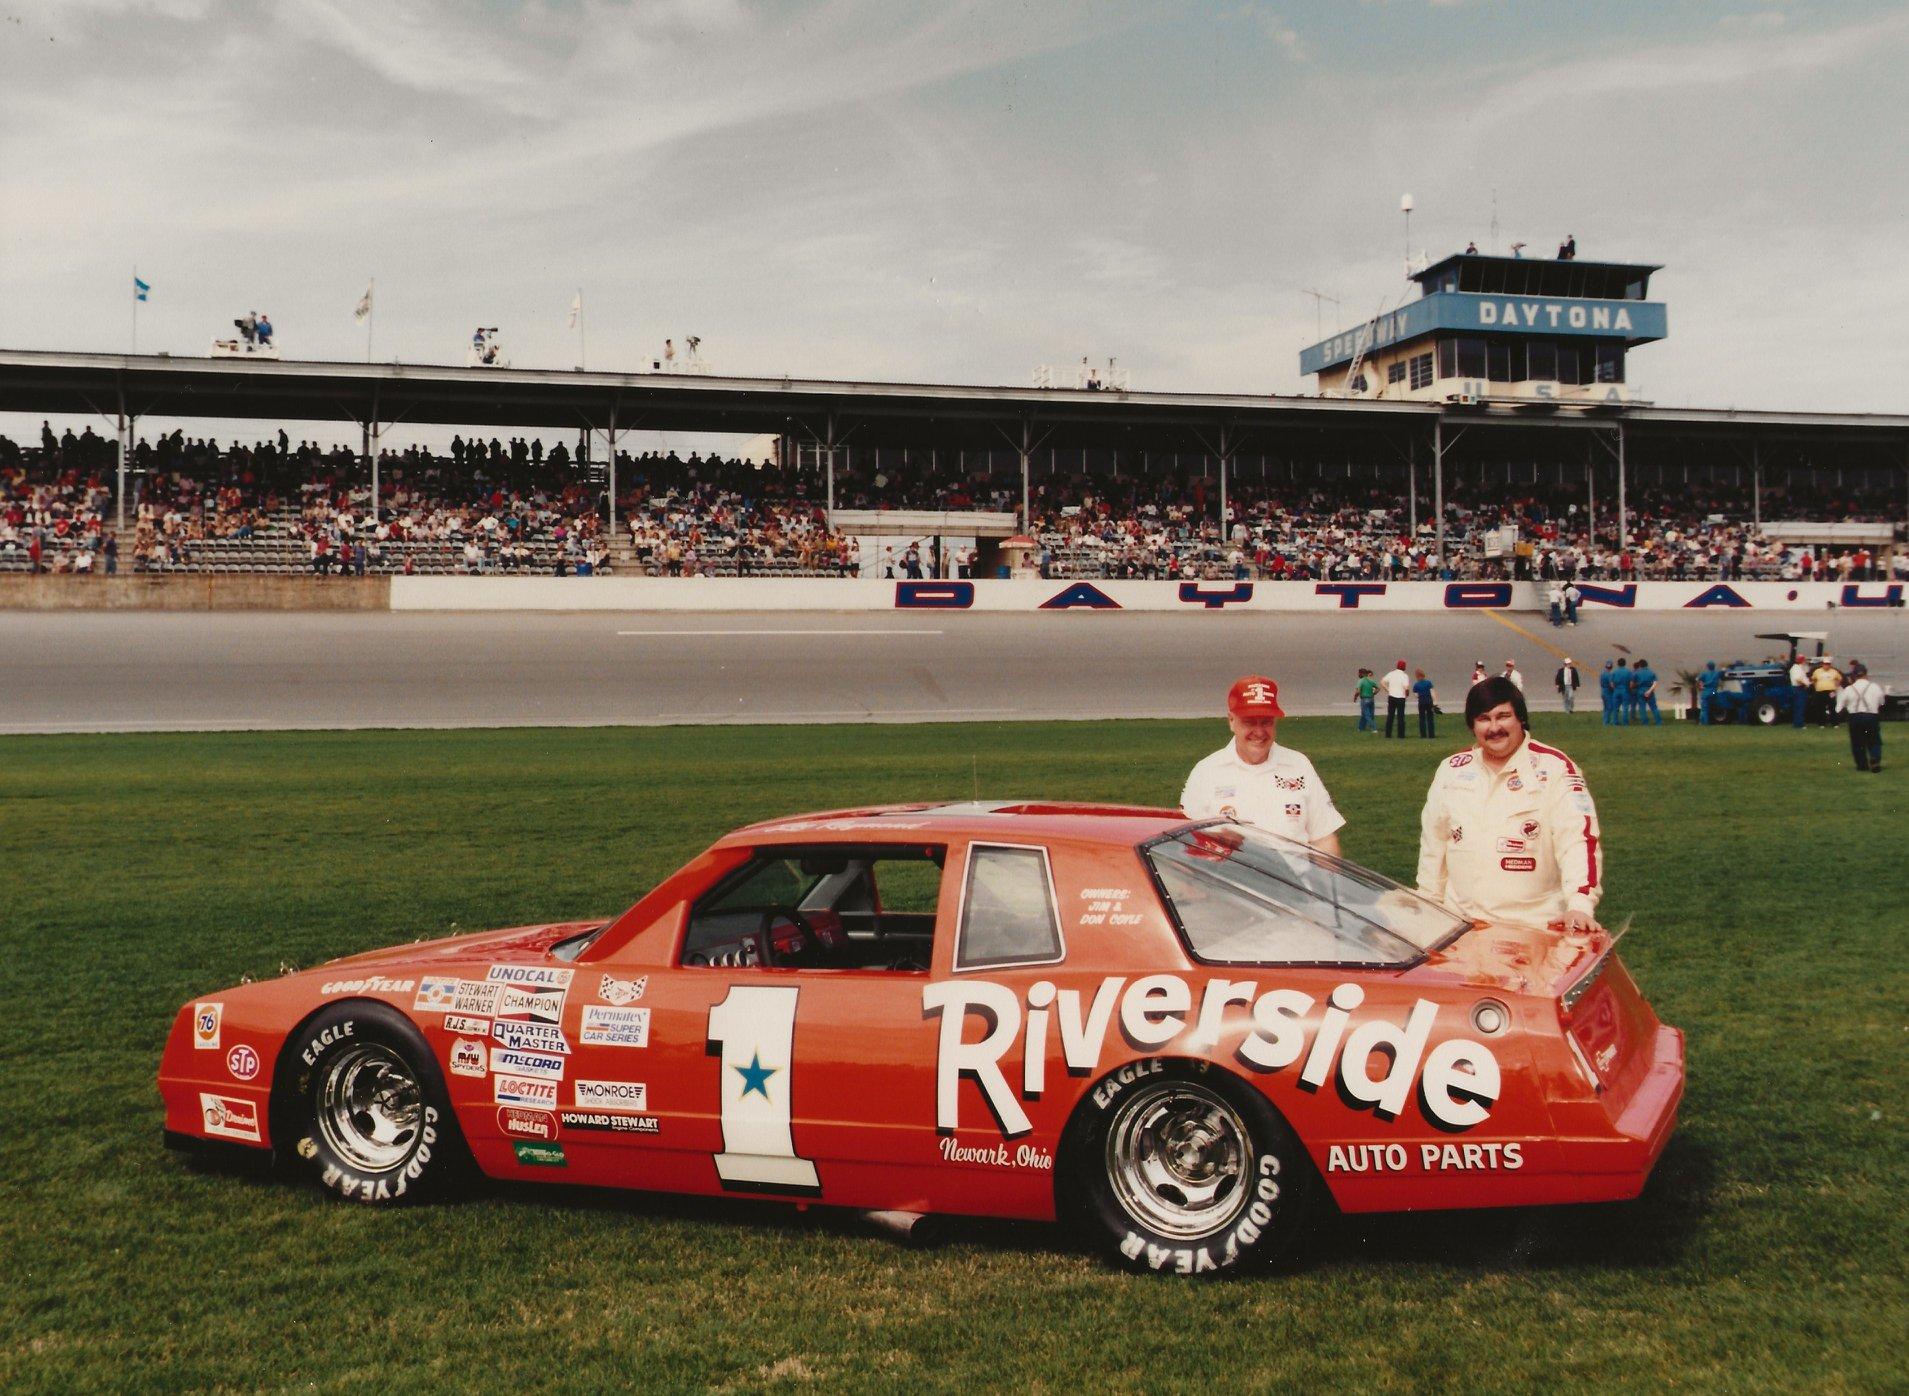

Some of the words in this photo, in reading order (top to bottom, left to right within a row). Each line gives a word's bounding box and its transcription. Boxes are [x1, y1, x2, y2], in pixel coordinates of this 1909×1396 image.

[1479, 301, 1633, 330] DAYTONA
[1088, 901, 1111, 912] JIM
[1080, 914, 1106, 925] DON
[490, 967, 555, 983] UNOCAL
[321, 976, 415, 994] GOODYEAR
[458, 982, 499, 998] STEWART
[454, 997, 494, 1013] WARNER
[504, 995, 559, 1012] CHAMPION
[199, 1011, 216, 1032] 76
[610, 1024, 642, 1034] SUPER
[494, 1022, 559, 1039] QUARTER
[583, 1032, 604, 1041] CAR
[606, 1033, 639, 1043] SERIES
[302, 1020, 354, 1066] EAGLE
[509, 1036, 565, 1052] MASTER
[230, 1048, 256, 1074] STP
[923, 974, 1501, 1136] Riverside
[499, 1080, 555, 1098] LOCTITE
[585, 1084, 634, 1099] MONROE
[707, 984, 821, 1190] 1
[1092, 1057, 1163, 1110] EAGLE
[561, 1113, 610, 1126] HOWARD
[610, 1117, 659, 1129] STEWART
[1327, 1144, 1408, 1173] AUTO
[1420, 1142, 1524, 1172] PARTS
